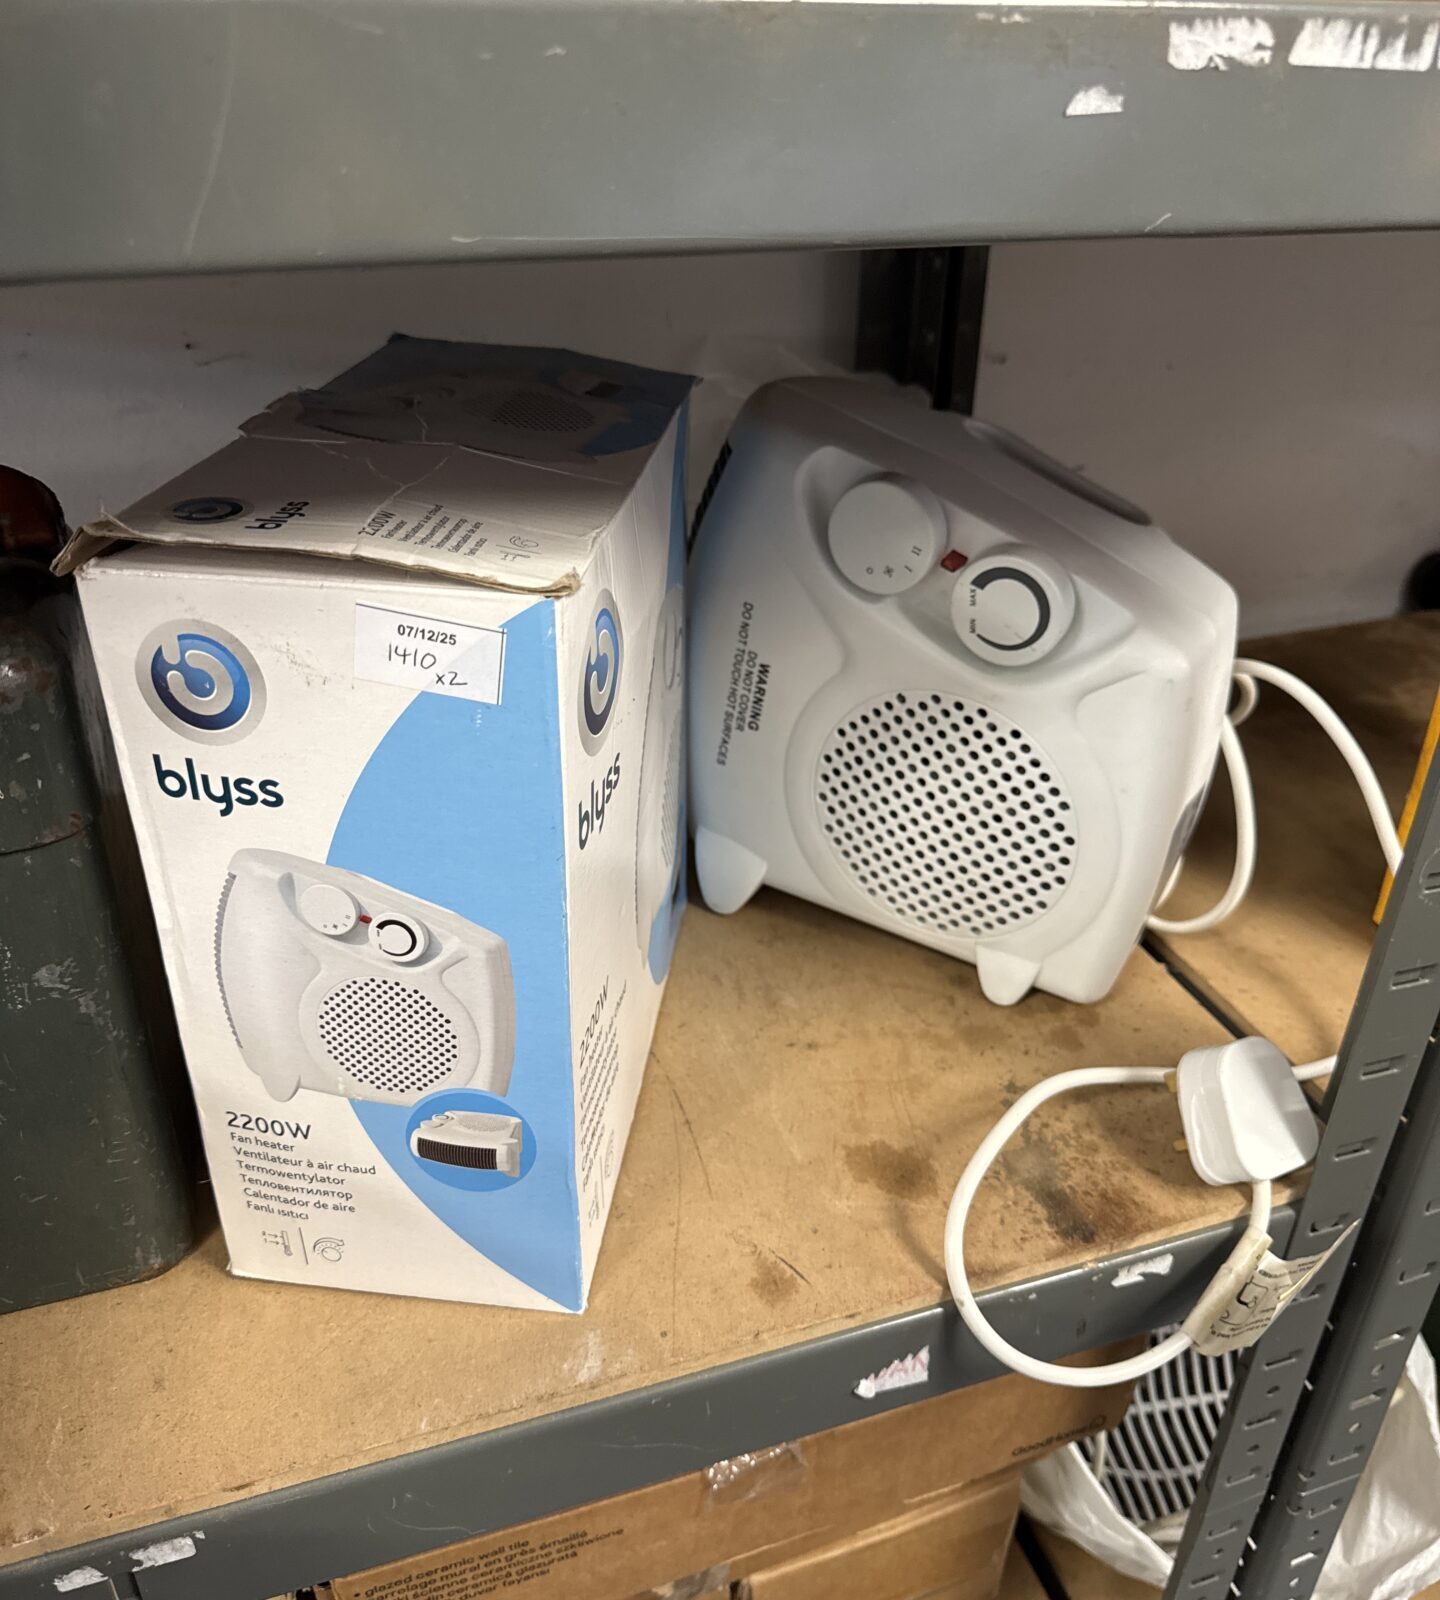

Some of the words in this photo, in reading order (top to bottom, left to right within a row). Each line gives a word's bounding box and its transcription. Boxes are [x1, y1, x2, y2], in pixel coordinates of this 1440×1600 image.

[245, 501, 309, 529] blyss
[742, 601, 754, 621] DO
[969, 588, 977, 607] MAX
[397, 624, 457, 646] 07/12/25
[738, 621, 749, 646] NOT
[388, 642, 437, 669] 1410
[731, 648, 746, 686] TOUCH
[745, 650, 758, 669] DO
[742, 669, 754, 692] NOT
[727, 686, 738, 711] HOT
[748, 661, 771, 732] WARNING
[735, 692, 750, 733] COVER
[716, 710, 734, 767] SURFACES
[152, 753, 285, 817] blyss
[579, 752, 620, 850] blyss
[580, 975, 609, 1069] 2200W
[225, 1111, 312, 1140] 2200W
[230, 1132, 252, 1145] Fan
[254, 1136, 295, 1152] heater
[233, 1146, 303, 1167] Ventilateur
[306, 1159, 314, 1169] à
[317, 1161, 334, 1171] air
[337, 1162, 376, 1175] chaud
[236, 1159, 346, 1186] Termowentylator
[240, 1173, 353, 1202] Тепловентилятор
[243, 1187, 310, 1207] Calentador
[313, 1199, 330, 1210] de
[332, 1202, 356, 1213] aire
[365, 1574, 413, 1598] glazed
[415, 1557, 475, 1580] ceramic
[478, 1544, 506, 1560] wall
[508, 1540, 530, 1551] tile
[440, 1563, 480, 1581] mural
[484, 1556, 502, 1568] en
[539, 1530, 588, 1551] émaillé
[471, 1550, 551, 1581] ceramiczne
[555, 1528, 625, 1553] szkliwione
